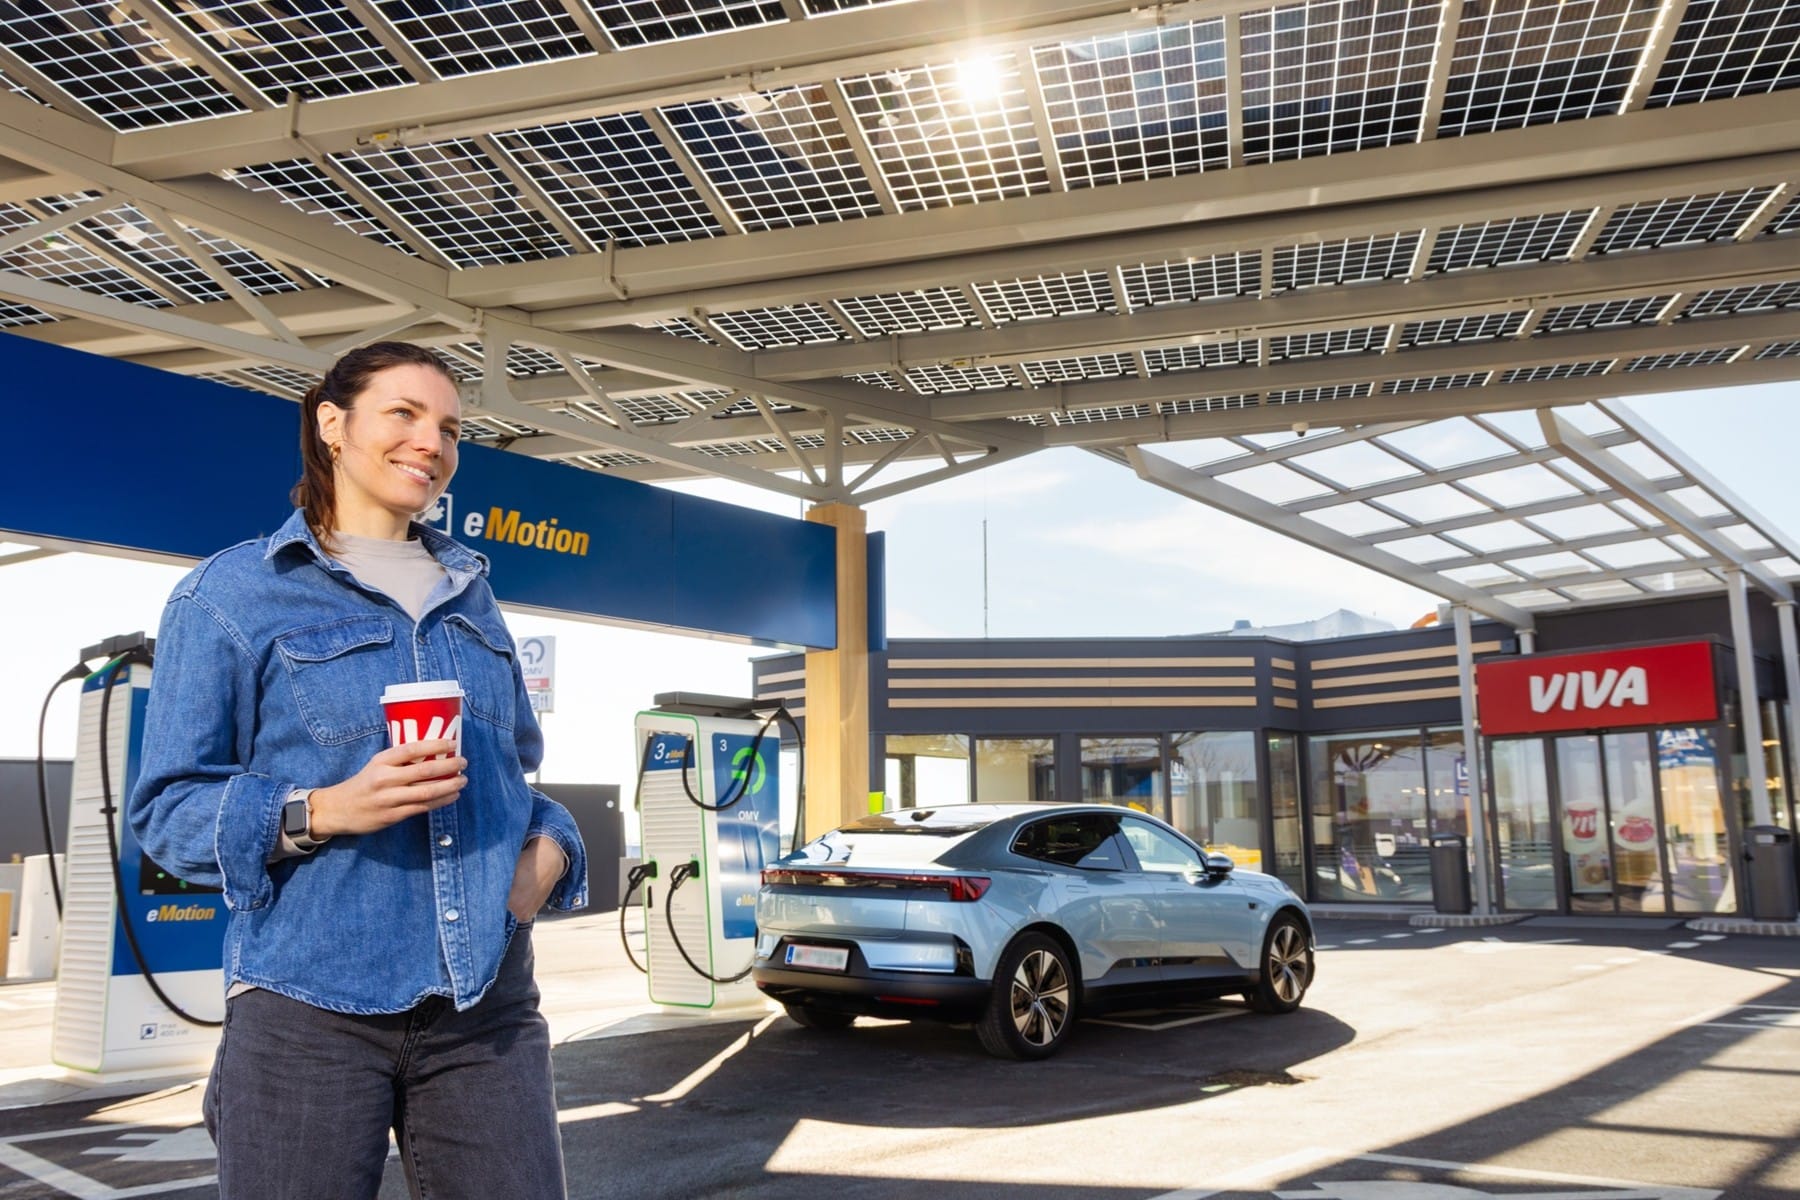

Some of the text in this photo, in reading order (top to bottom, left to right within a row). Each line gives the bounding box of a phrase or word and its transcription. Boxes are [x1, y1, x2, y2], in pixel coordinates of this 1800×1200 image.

[463, 506, 590, 557] eMotion
[1529, 666, 1649, 713] VIVA
[386, 714, 462, 764] IVA
[719, 739, 728, 752] 3
[654, 742, 666, 760] 3
[738, 810, 760, 821] OMV
[146, 904, 216, 922] eMotion
